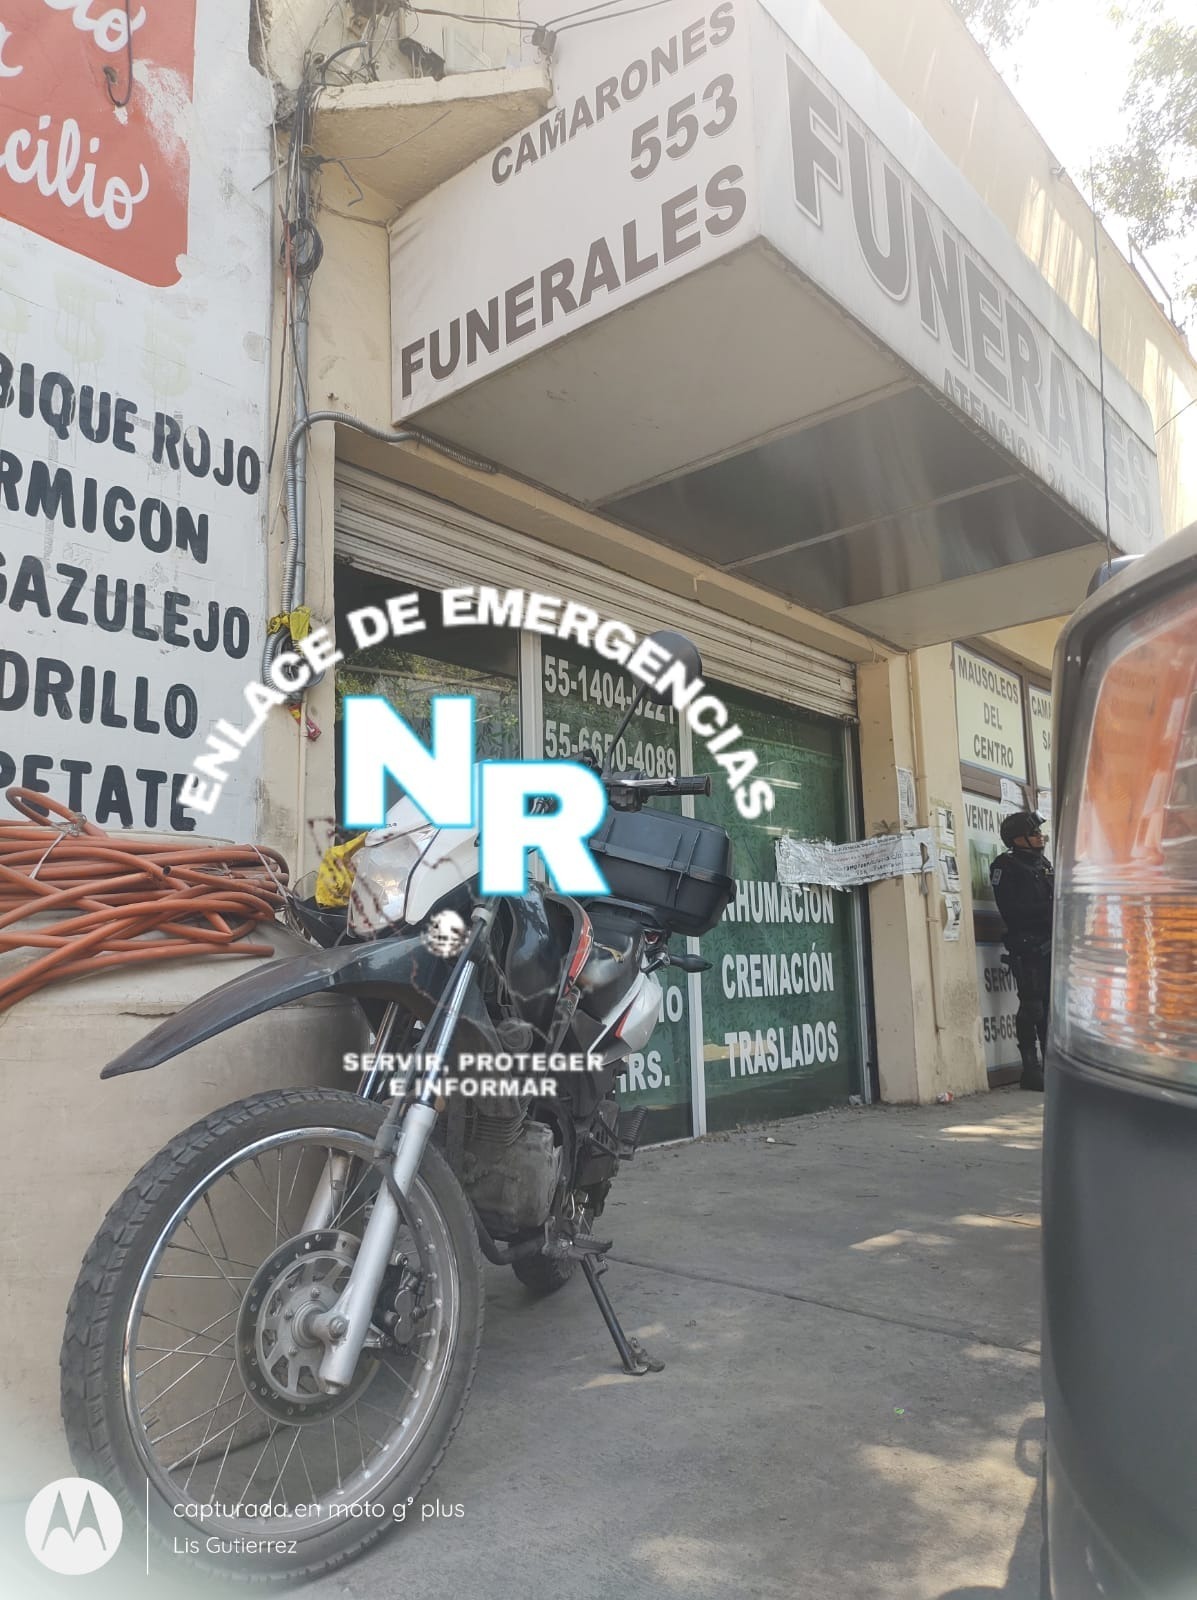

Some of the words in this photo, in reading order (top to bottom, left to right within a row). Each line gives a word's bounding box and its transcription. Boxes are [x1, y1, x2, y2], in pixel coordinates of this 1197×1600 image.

[491, 1, 736, 186] CAMARONES
[630, 73, 738, 181] 553
[401, 164, 747, 400] FUNERALES
[786, 52, 1153, 540] FUNERALES
[152, 411, 261, 494] ROJO
[0, 449, 210, 564] RMIGON
[0, 550, 250, 660] AZULEJO
[0, 649, 199, 740] DRILLO
[958, 654, 1020, 705] MAUSOLEOS
[983, 701, 1004, 731] DEL
[973, 734, 1015, 769] CENTRO
[965, 802, 996, 834] VENTA
[721, 942, 835, 1000] CREMACIÓN
[724, 1020, 840, 1078] TRASLADOS
